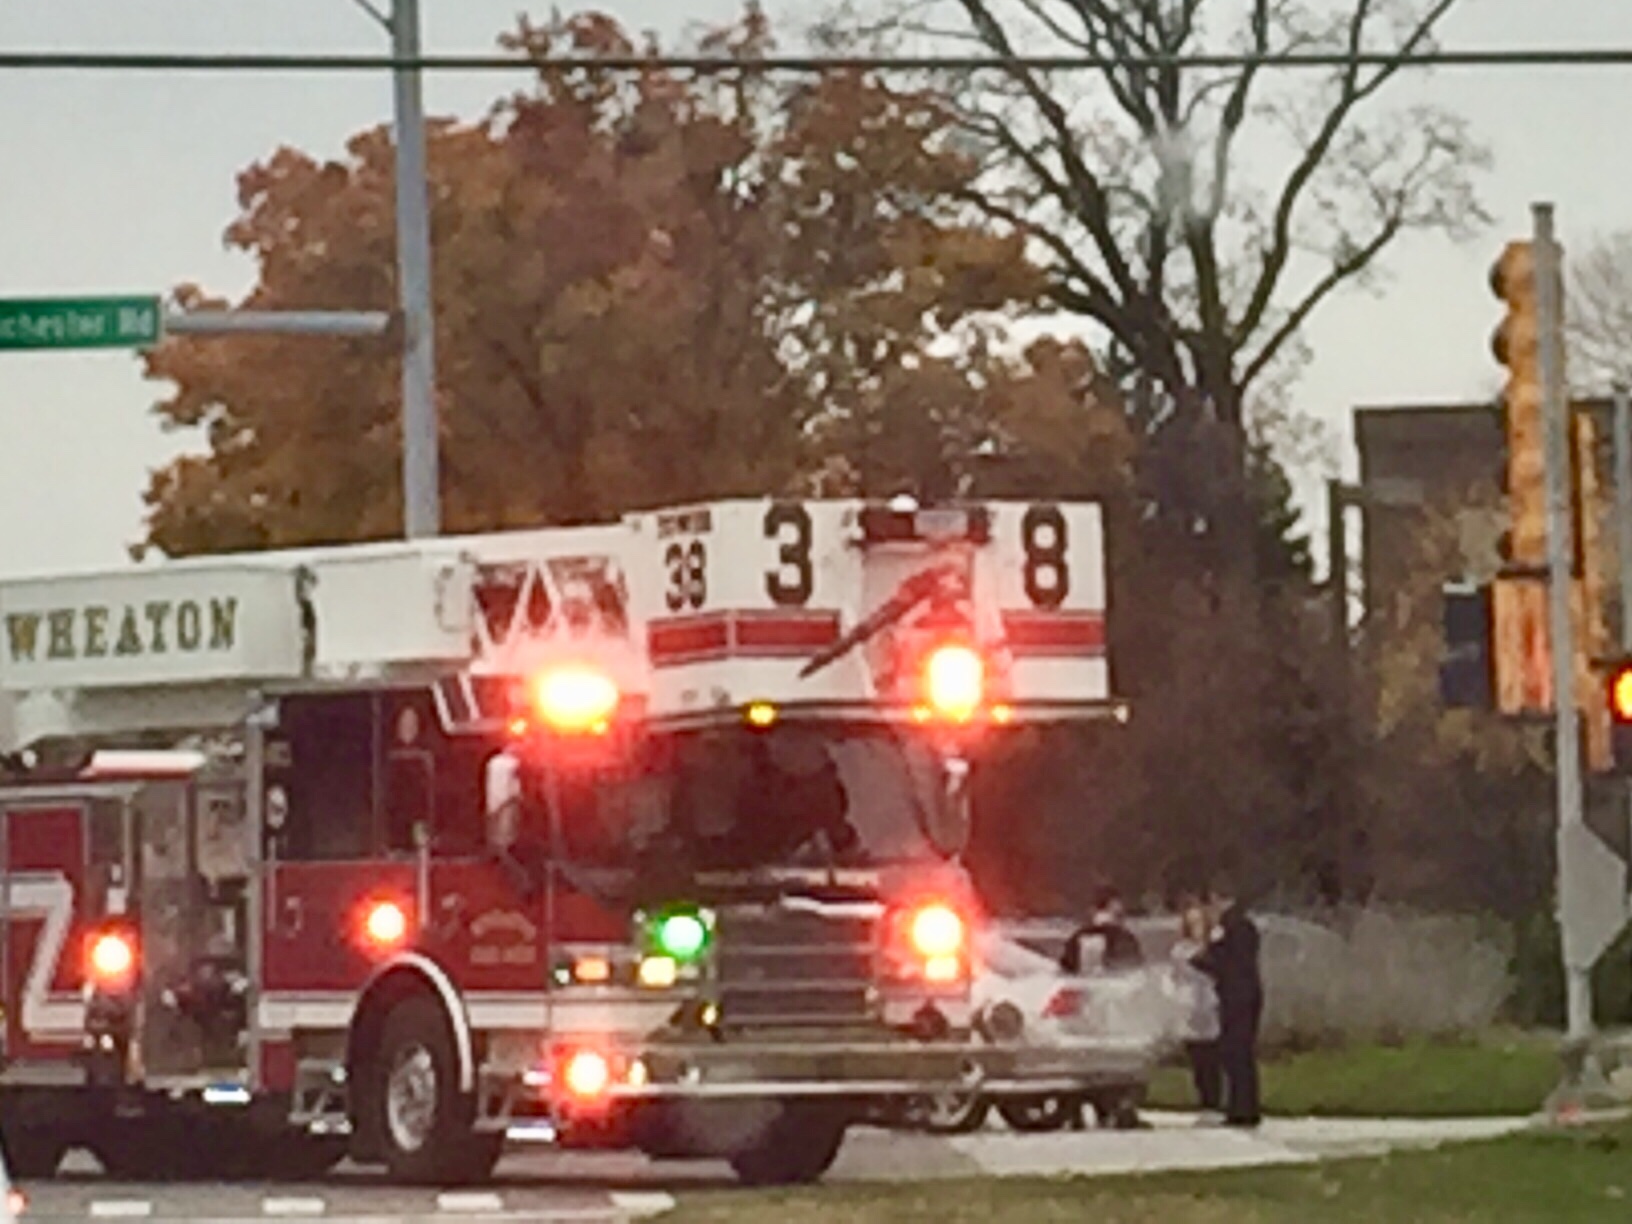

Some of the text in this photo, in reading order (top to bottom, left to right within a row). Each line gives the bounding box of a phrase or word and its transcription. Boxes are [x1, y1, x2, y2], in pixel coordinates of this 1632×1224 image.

[119, 307, 152, 336] Rd
[764, 500, 1069, 610] 3 8
[6, 596, 237, 661] WHEATON
